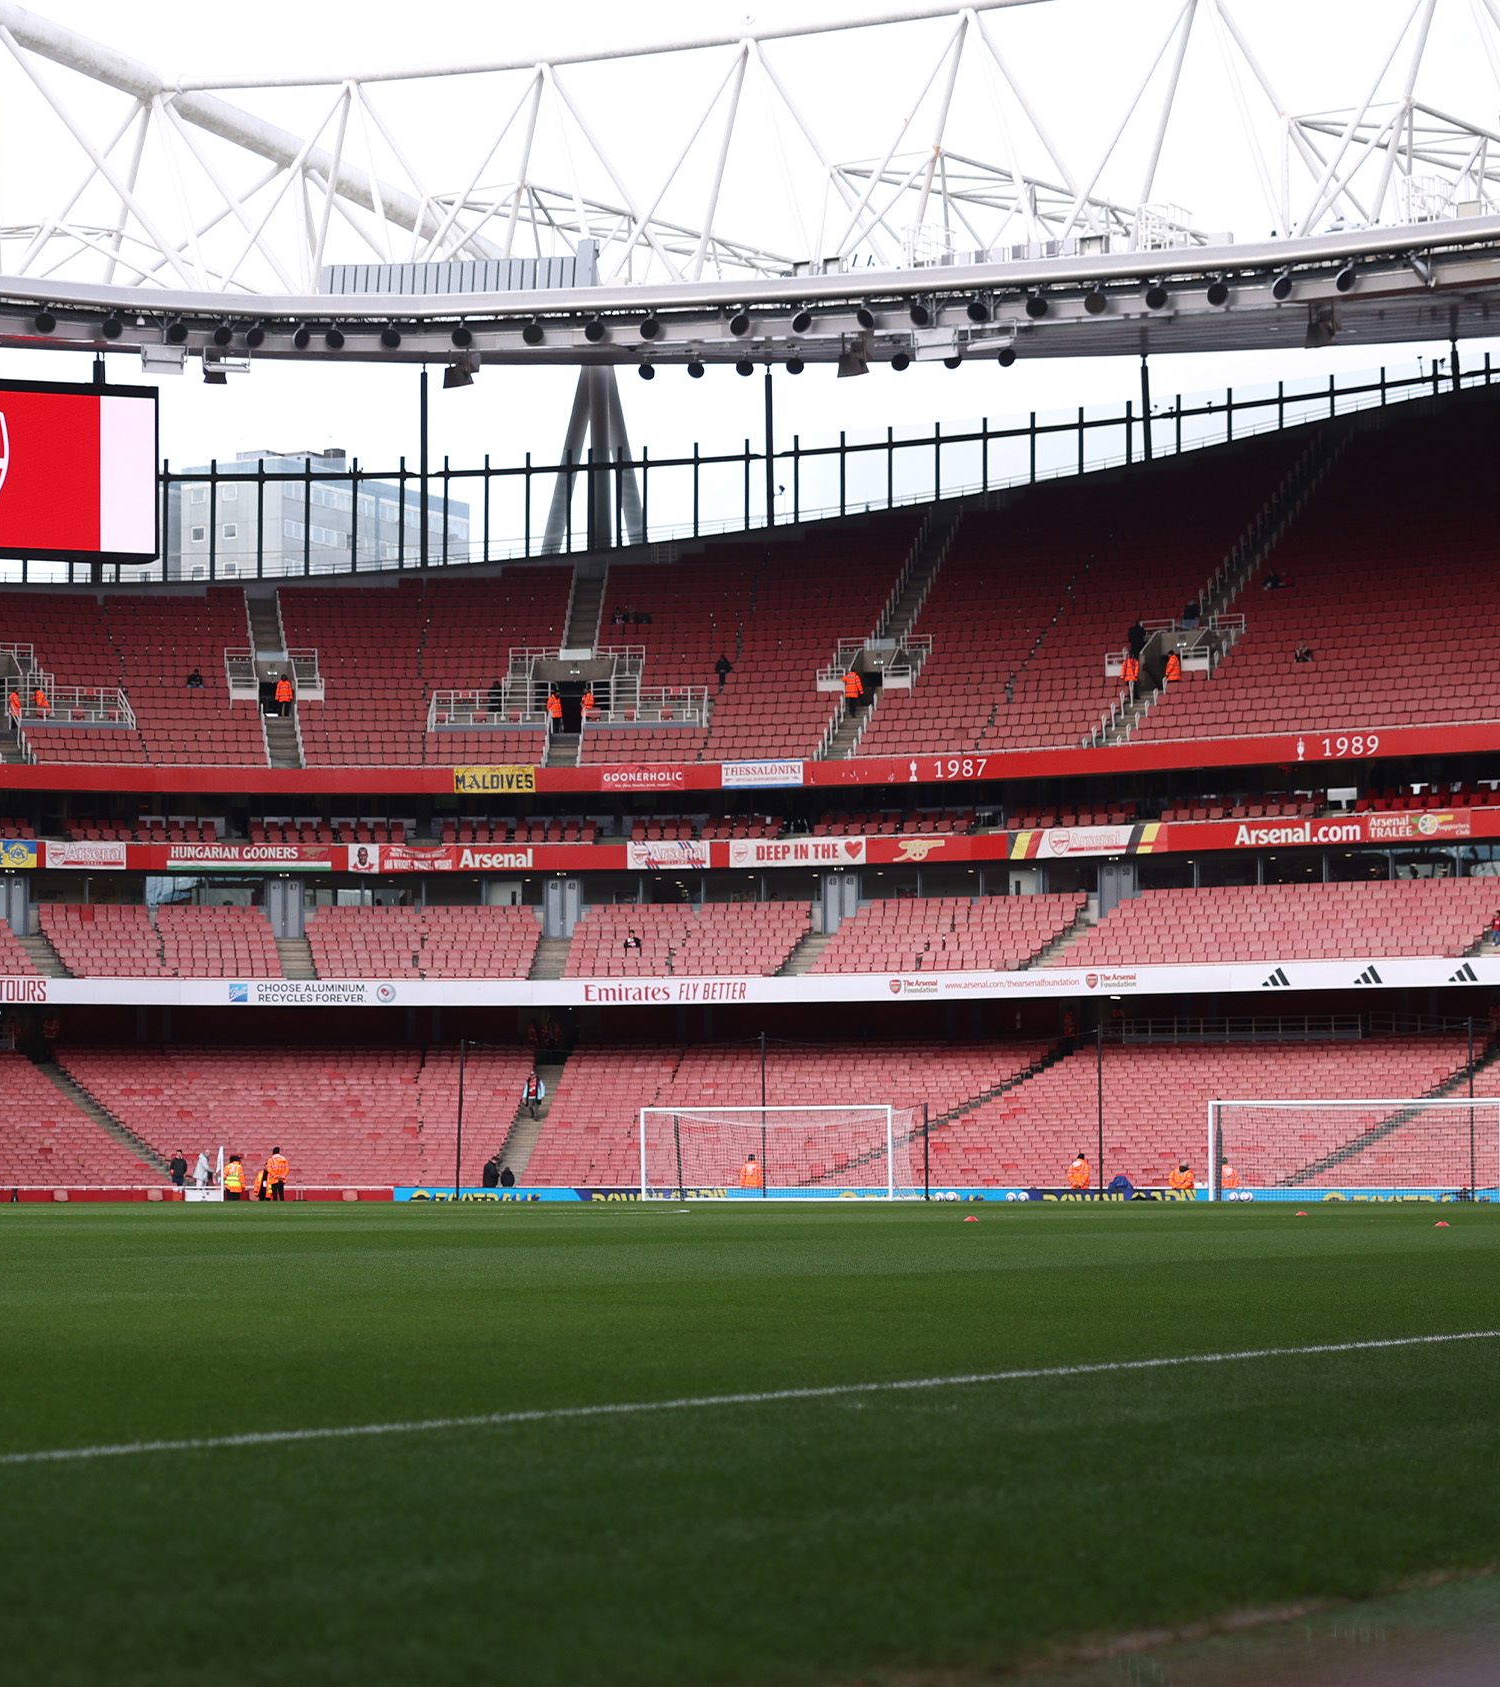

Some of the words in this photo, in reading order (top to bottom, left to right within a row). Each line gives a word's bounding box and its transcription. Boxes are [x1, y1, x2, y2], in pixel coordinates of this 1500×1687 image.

[1322, 734, 1380, 757] 1989
[933, 758, 989, 779] 1987
[455, 774, 534, 791] MALDIVES
[602, 771, 683, 783] GOONERHOLIC
[1368, 815, 1410, 828] Arsenal
[1071, 831, 1120, 848] Arsenal
[1234, 821, 1361, 846] Arsenal.com
[1369, 826, 1412, 838] TRALEE
[66, 843, 125, 861] Arsenal
[170, 845, 240, 859] HUNGARIAN
[242, 845, 299, 860] GOONERS
[459, 848, 533, 868] Arsenal
[651, 843, 706, 860] Arsenal
[756, 844, 792, 861] DEEP
[794, 844, 809, 860] IN
[811, 843, 839, 860] THE
[903, 979, 914, 988] The
[914, 979, 938, 988] Arsenal
[944, 977, 1080, 991] www.arsenal.com/thearsenalfoundation
[1100, 973, 1111, 982] The
[1111, 972, 1137, 982] Arsenal
[1100, 980, 1137, 989] Foundation
[256, 983, 302, 993] CHOOSE
[304, 983, 368, 993] ALUMINIUM.
[583, 983, 671, 1002] Emirates
[678, 983, 699, 1001] FLY
[702, 981, 747, 1001] BETTER
[903, 985, 938, 995] Foundation
[258, 993, 313, 1003] RECYCLES
[315, 993, 367, 1003] FOREVER.
